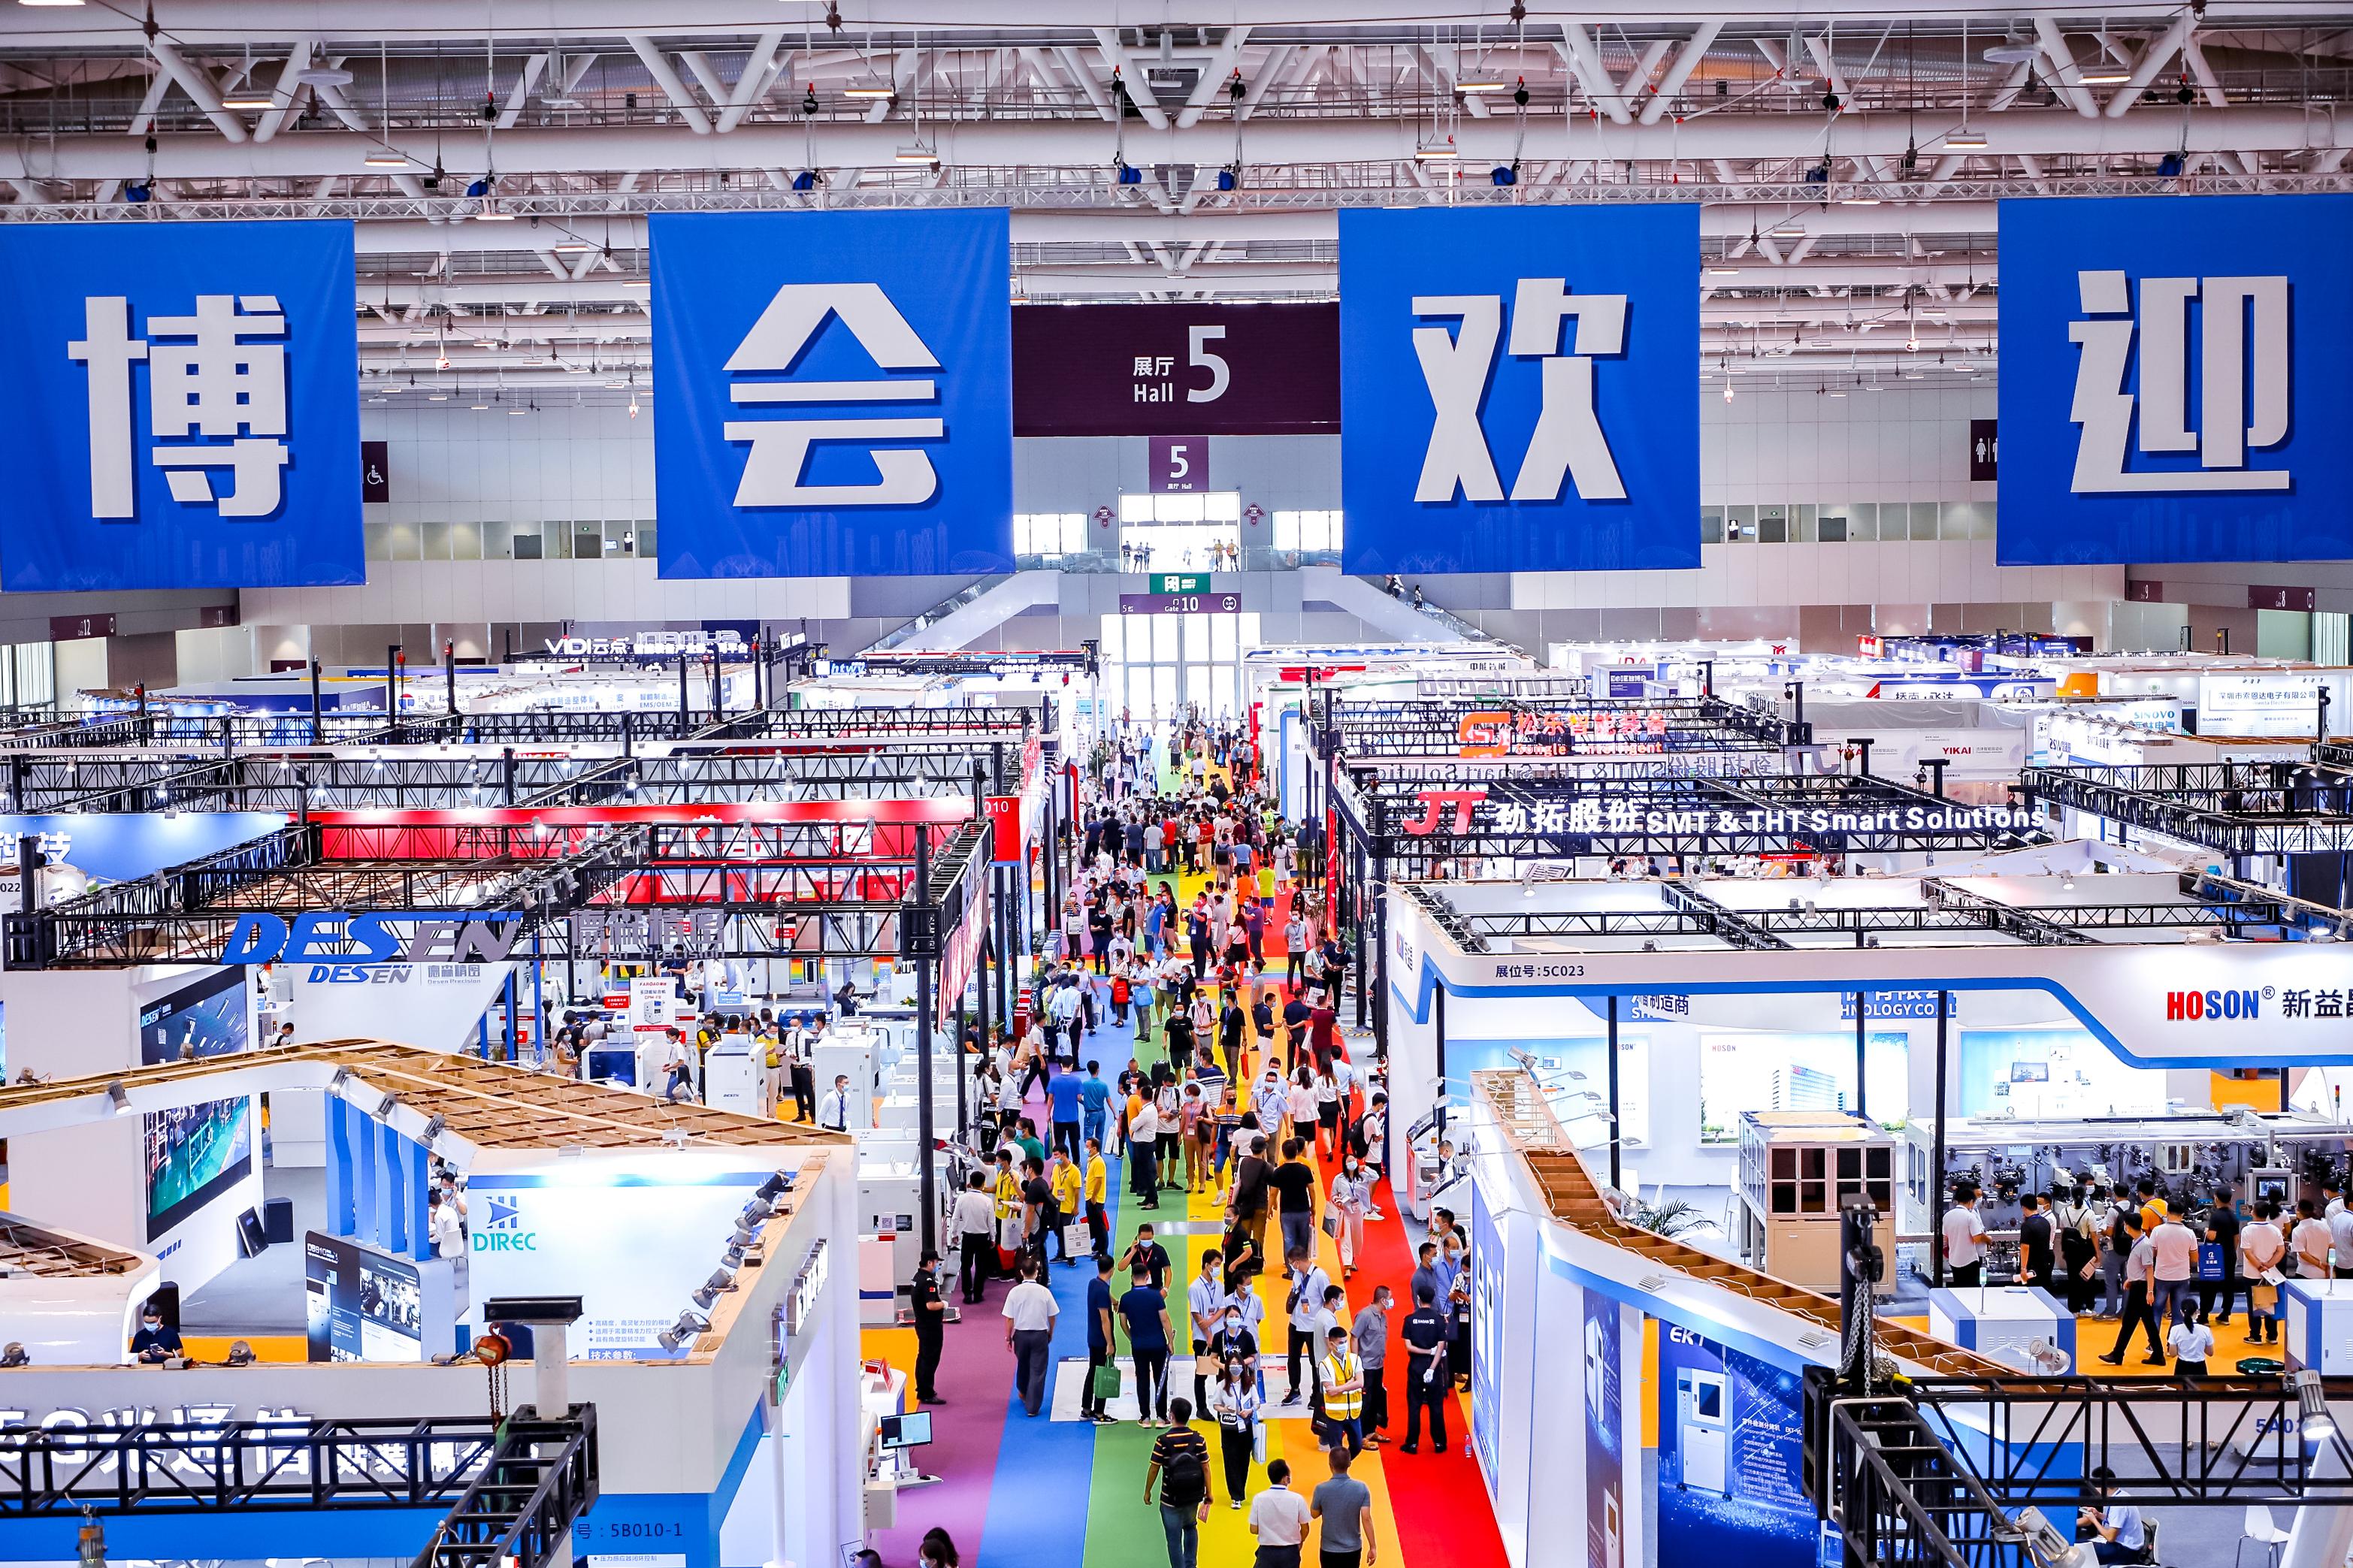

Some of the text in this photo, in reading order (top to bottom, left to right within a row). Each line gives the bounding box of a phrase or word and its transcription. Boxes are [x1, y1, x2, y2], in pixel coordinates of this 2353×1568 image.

[1133, 325, 1229, 403] 展厅 5
[1134, 383, 1173, 402] Hall
[1412, 278, 1627, 502] 欢
[2069, 270, 2290, 493] 迎
[68, 295, 289, 518] 博
[723, 283, 943, 507] 会
[1169, 446, 1189, 479] 5
[1181, 597, 1199, 612] 10
[2144, 585, 2149, 600] 9
[2281, 590, 2286, 607] 8
[83, 619, 91, 636] 12
[2134, 710, 2176, 719] SINOVO
[1942, 747, 1971, 755] YIKAI
[1402, 790, 2045, 835] JT 劲拓股份 SMT & THT Smart Solutions
[222, 911, 525, 965] DESEN
[307, 965, 413, 984] DESEN
[2167, 988, 2353, 1020] HOSON 新益
[472, 1232, 537, 1252] DIREC
